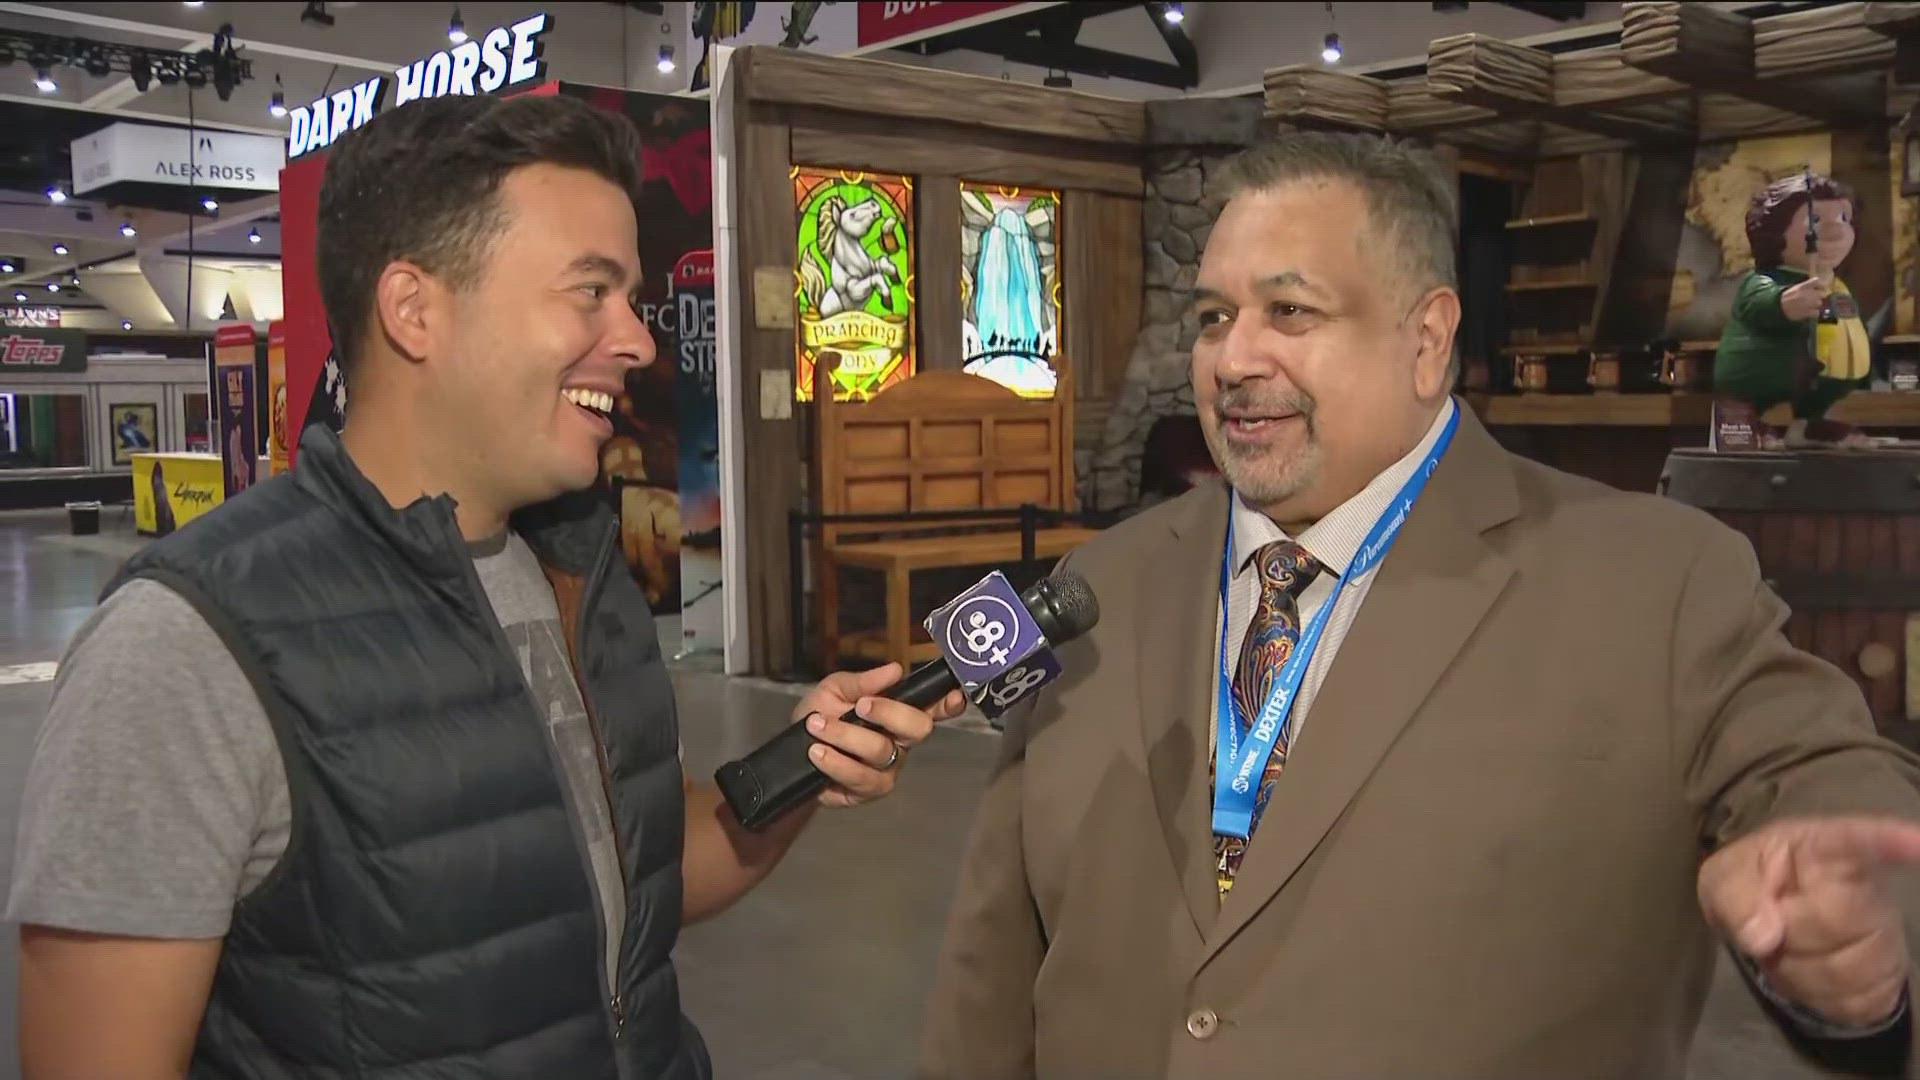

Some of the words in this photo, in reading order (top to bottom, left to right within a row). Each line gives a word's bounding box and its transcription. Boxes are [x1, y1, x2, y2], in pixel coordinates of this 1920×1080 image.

[289, 77, 381, 158] DARK
[395, 14, 545, 107] HORSE
[156, 161, 203, 178] ALEX
[210, 164, 255, 182] ROSS
[844, 354, 876, 367] ony
[1254, 687, 1290, 743] DEXTER
